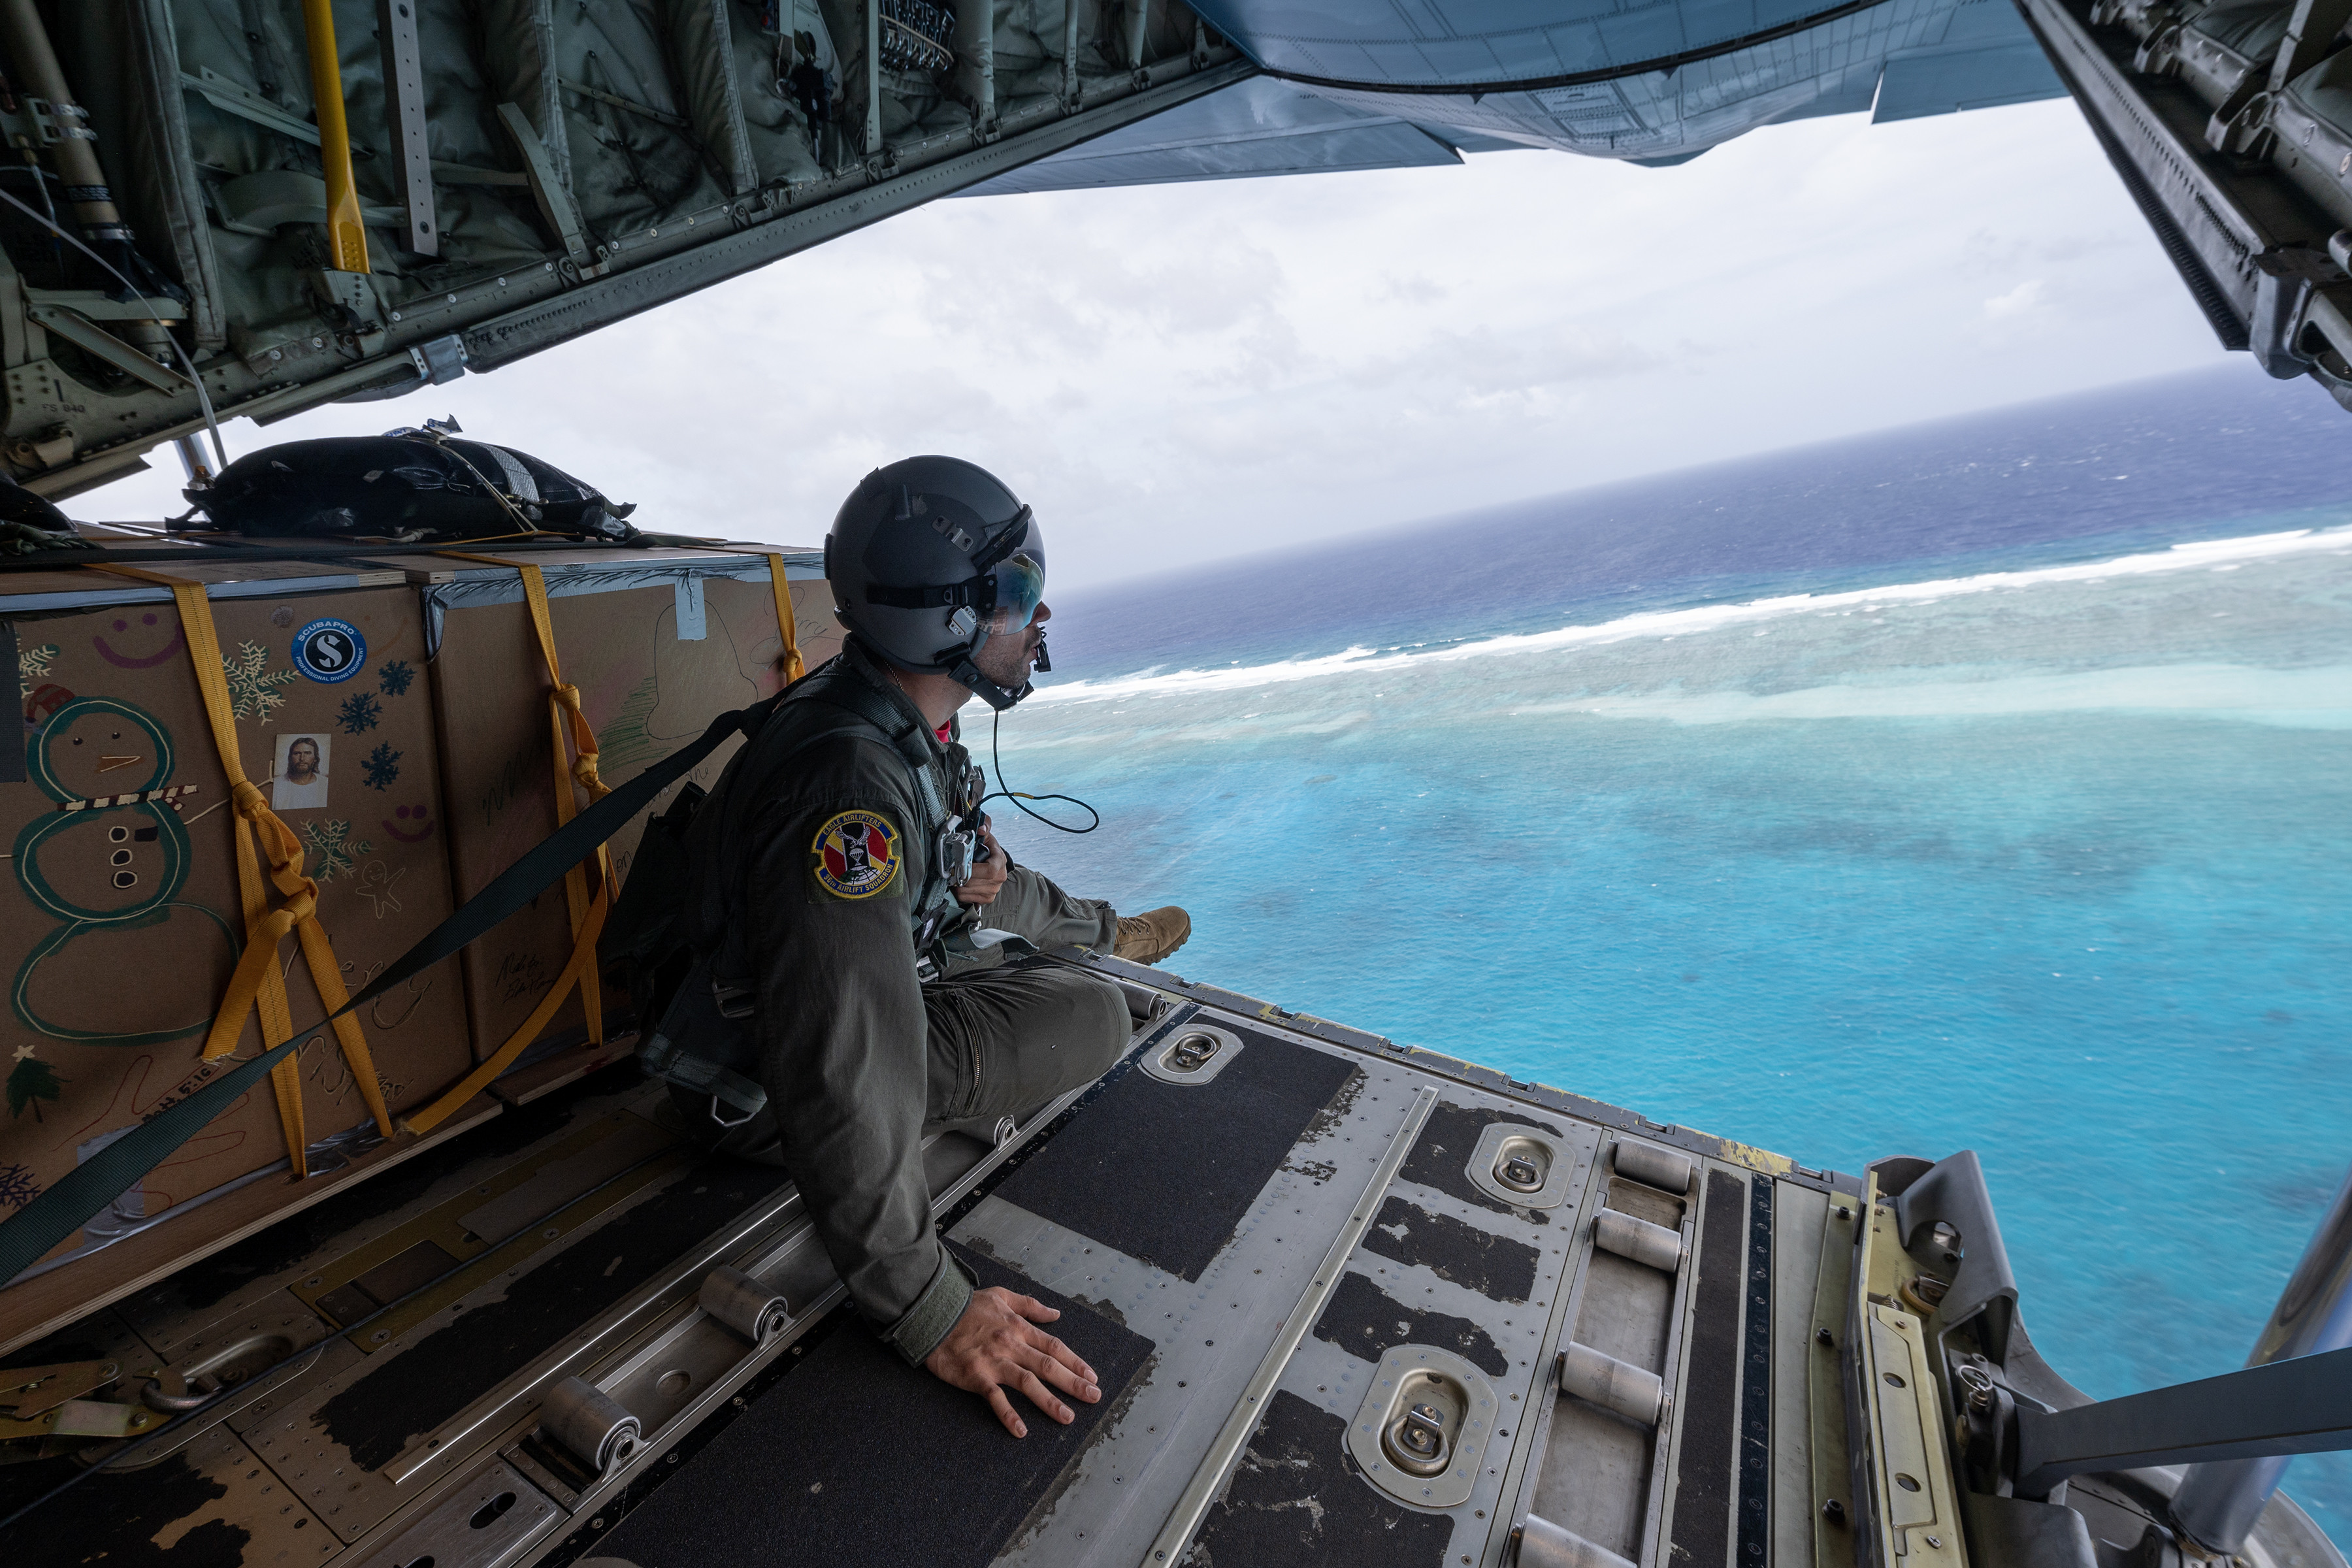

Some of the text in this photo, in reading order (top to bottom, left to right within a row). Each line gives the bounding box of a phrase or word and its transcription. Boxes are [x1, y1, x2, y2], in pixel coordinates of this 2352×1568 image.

[298, 621, 355, 642] SCUBAPRO
[296, 647, 363, 681] PROFESSIONAL DIVING EQUIPMENT
[823, 815, 882, 836] EAGLE AIRLIFTERS
[838, 884, 863, 893] AIRLIFT
[865, 864, 894, 891] SQUADRON
